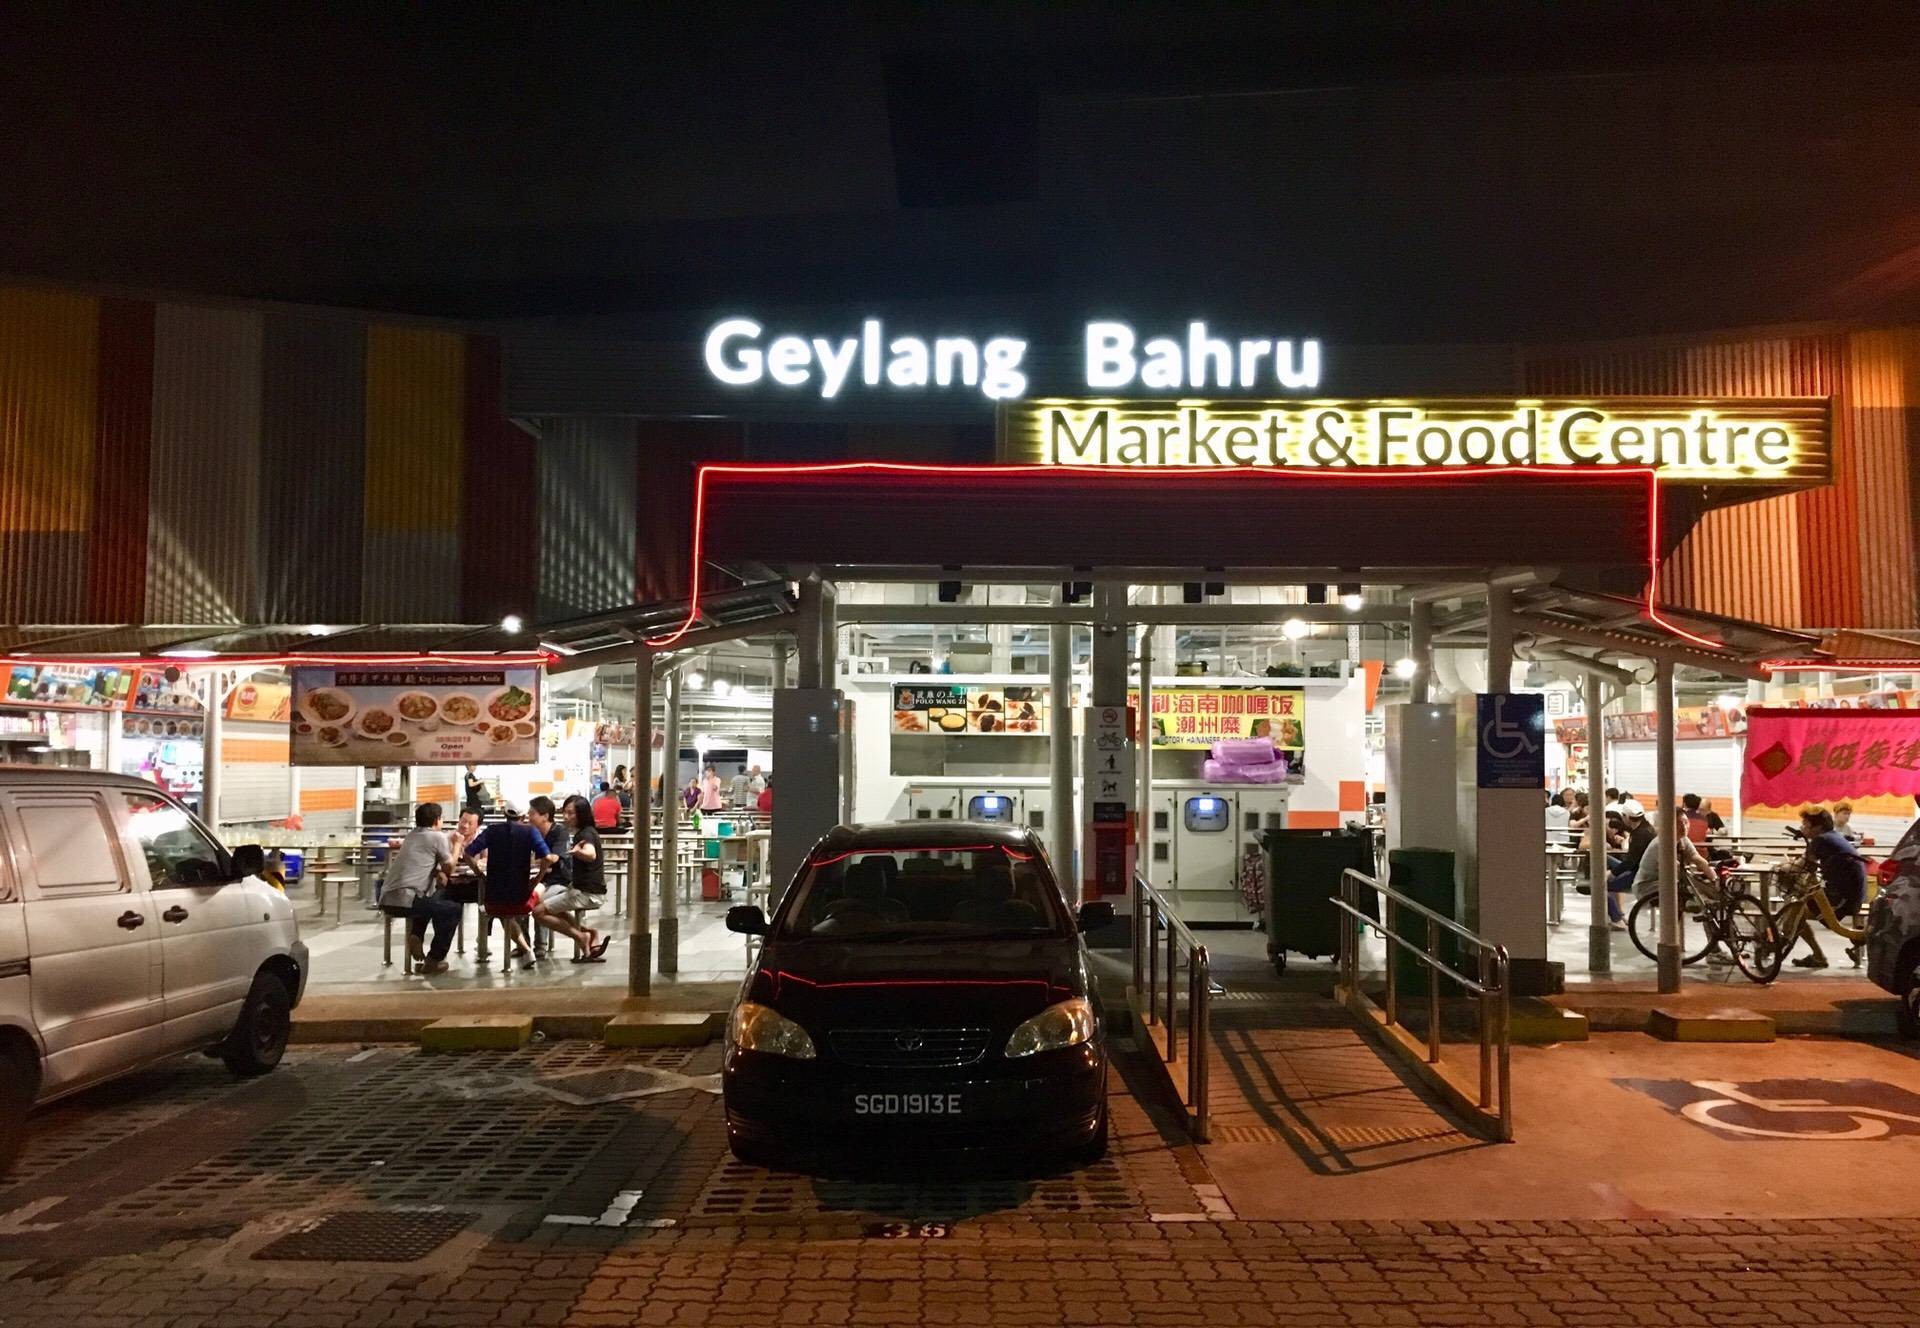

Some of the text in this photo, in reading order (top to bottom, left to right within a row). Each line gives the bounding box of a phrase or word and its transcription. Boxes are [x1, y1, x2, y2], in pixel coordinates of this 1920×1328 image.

[705, 319, 1320, 399] Geylang Bahru
[1051, 410, 1789, 466] Market & Food Centre
[855, 1094, 962, 1114] SGD1913E
